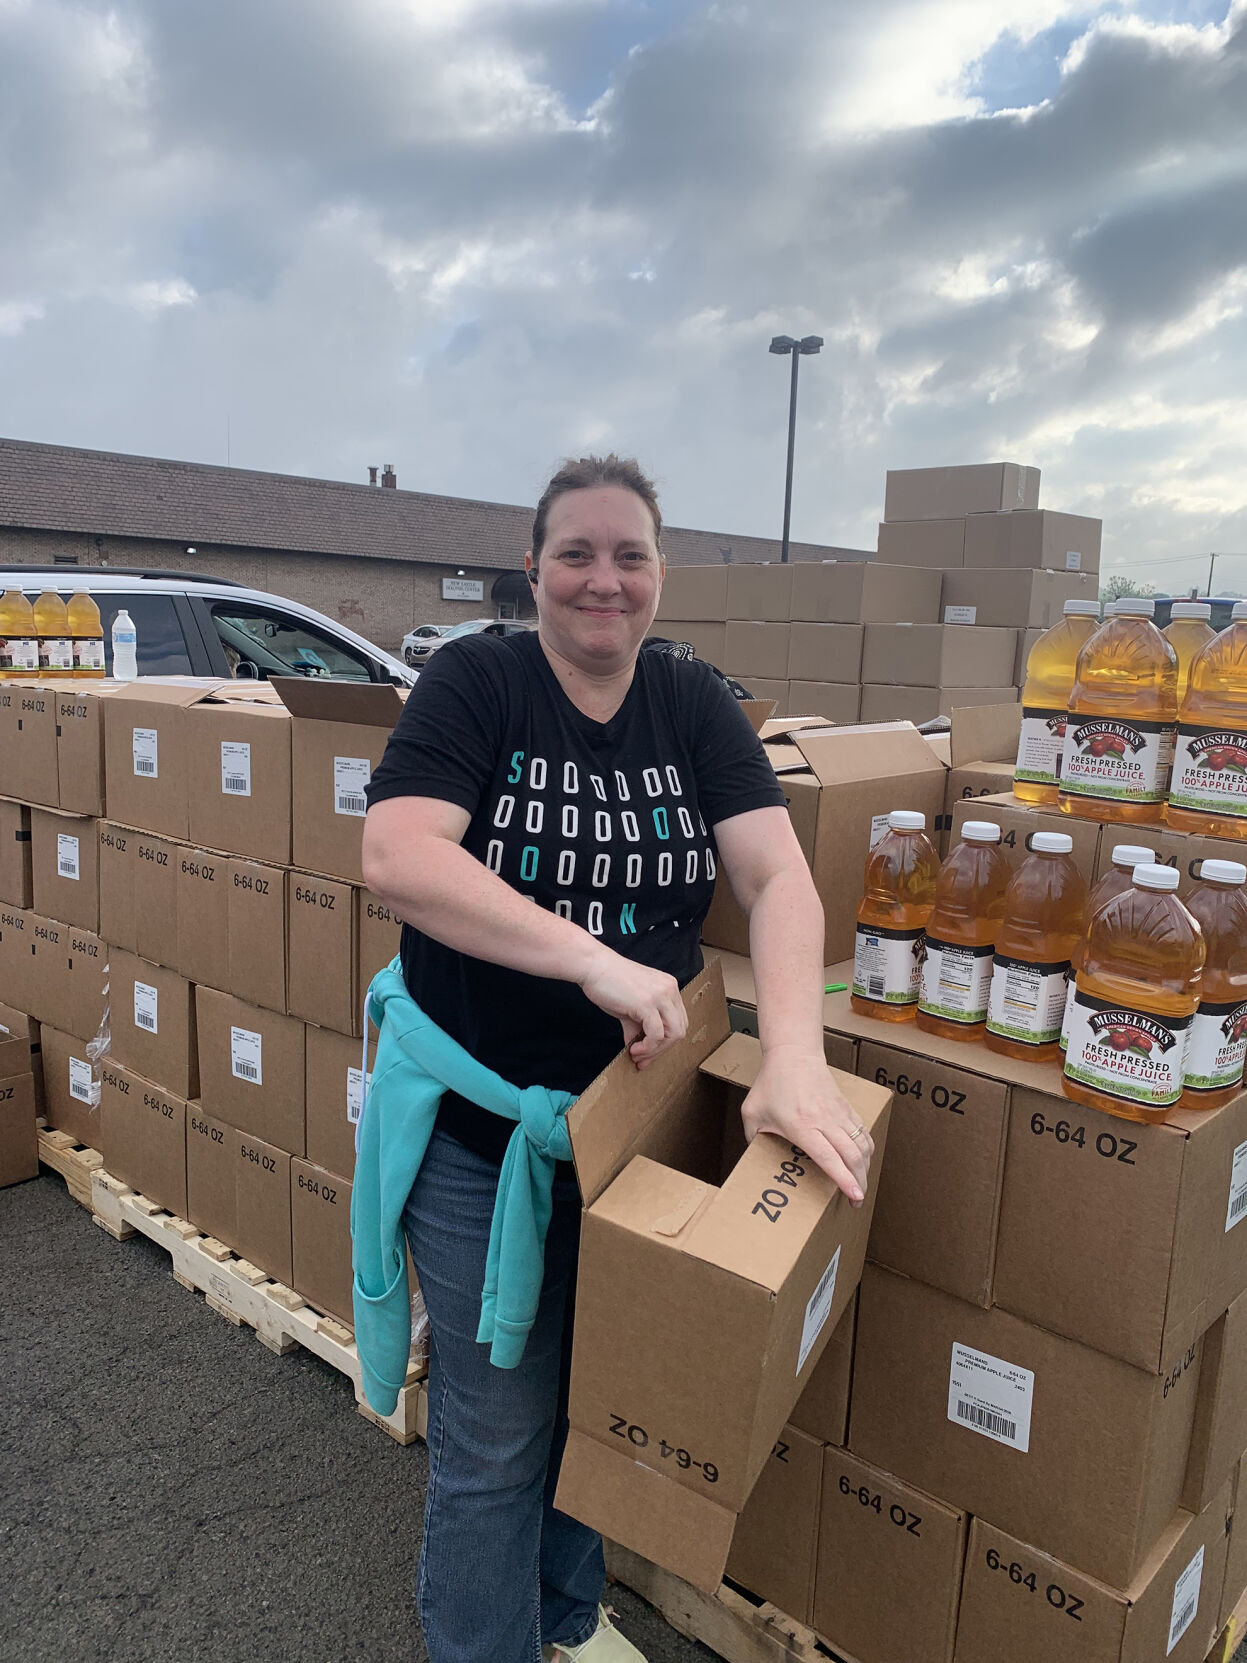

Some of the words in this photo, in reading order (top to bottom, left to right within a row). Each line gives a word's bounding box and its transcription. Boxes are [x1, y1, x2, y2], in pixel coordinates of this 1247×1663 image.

[22, 699, 35, 711] 6-64
[36, 701, 45, 712] OZ
[61, 705, 75, 716] 6-64
[77, 706, 87, 718] OZ
[1071, 755, 1097, 765] FRESH
[1099, 759, 1141, 771] PRESSED
[1084, 766, 1112, 776] APPLE
[1114, 770, 1144, 780] JUICE
[1185, 769, 1215, 780] FRESH
[1201, 780, 1233, 791] APPLE
[101, 832, 114, 847] 6-64
[116, 838, 126, 851] OZ
[139, 846, 154, 861] 6-64
[156, 852, 168, 866] OZ
[182, 860, 199, 877] 6-64
[201, 866, 214, 881] OZ
[234, 873, 252, 890] 6-64
[255, 879, 269, 894] OZ
[296, 887, 316, 905] 6-64
[320, 893, 335, 910] OZ
[2, 913, 14, 926] 6-64
[15, 918, 24, 930] OZ
[367, 904, 390, 922] 6-64
[35, 926, 47, 939] 6-64
[49, 931, 58, 943] OZ
[72, 939, 86, 954] 6-64
[87, 944, 98, 958] OZ
[1081, 1051, 1101, 1063] 100%
[1102, 1058, 1136, 1075] APPLE
[1138, 1069, 1172, 1081] JUICE
[1085, 1043, 1117, 1060] FRESH
[1120, 1054, 1170, 1071] PRESSED
[103, 1070, 117, 1087] 6-64
[119, 1080, 130, 1095] OZ
[874, 1067, 923, 1100] 6-64
[930, 1085, 967, 1115] OZ
[143, 1094, 159, 1112] 6-64
[161, 1103, 174, 1119] OZ
[191, 1118, 208, 1136] 6-64
[211, 1127, 224, 1144] OZ
[1030, 1112, 1086, 1148] 6-64
[1095, 1132, 1138, 1165] OZ
[241, 1145, 259, 1165] 6-64
[262, 1155, 276, 1173] OZ
[298, 1175, 318, 1195] 6-64
[321, 1185, 336, 1205] OZ
[987, 1367, 1002, 1377] APPLE
[609, 1413, 648, 1447] OZ
[659, 1439, 719, 1483] 6-64
[839, 1475, 882, 1514] 6-64
[889, 1504, 922, 1538] OZ
[986, 1549, 1037, 1593] 6-64
[1046, 1584, 1085, 1622] OZ
